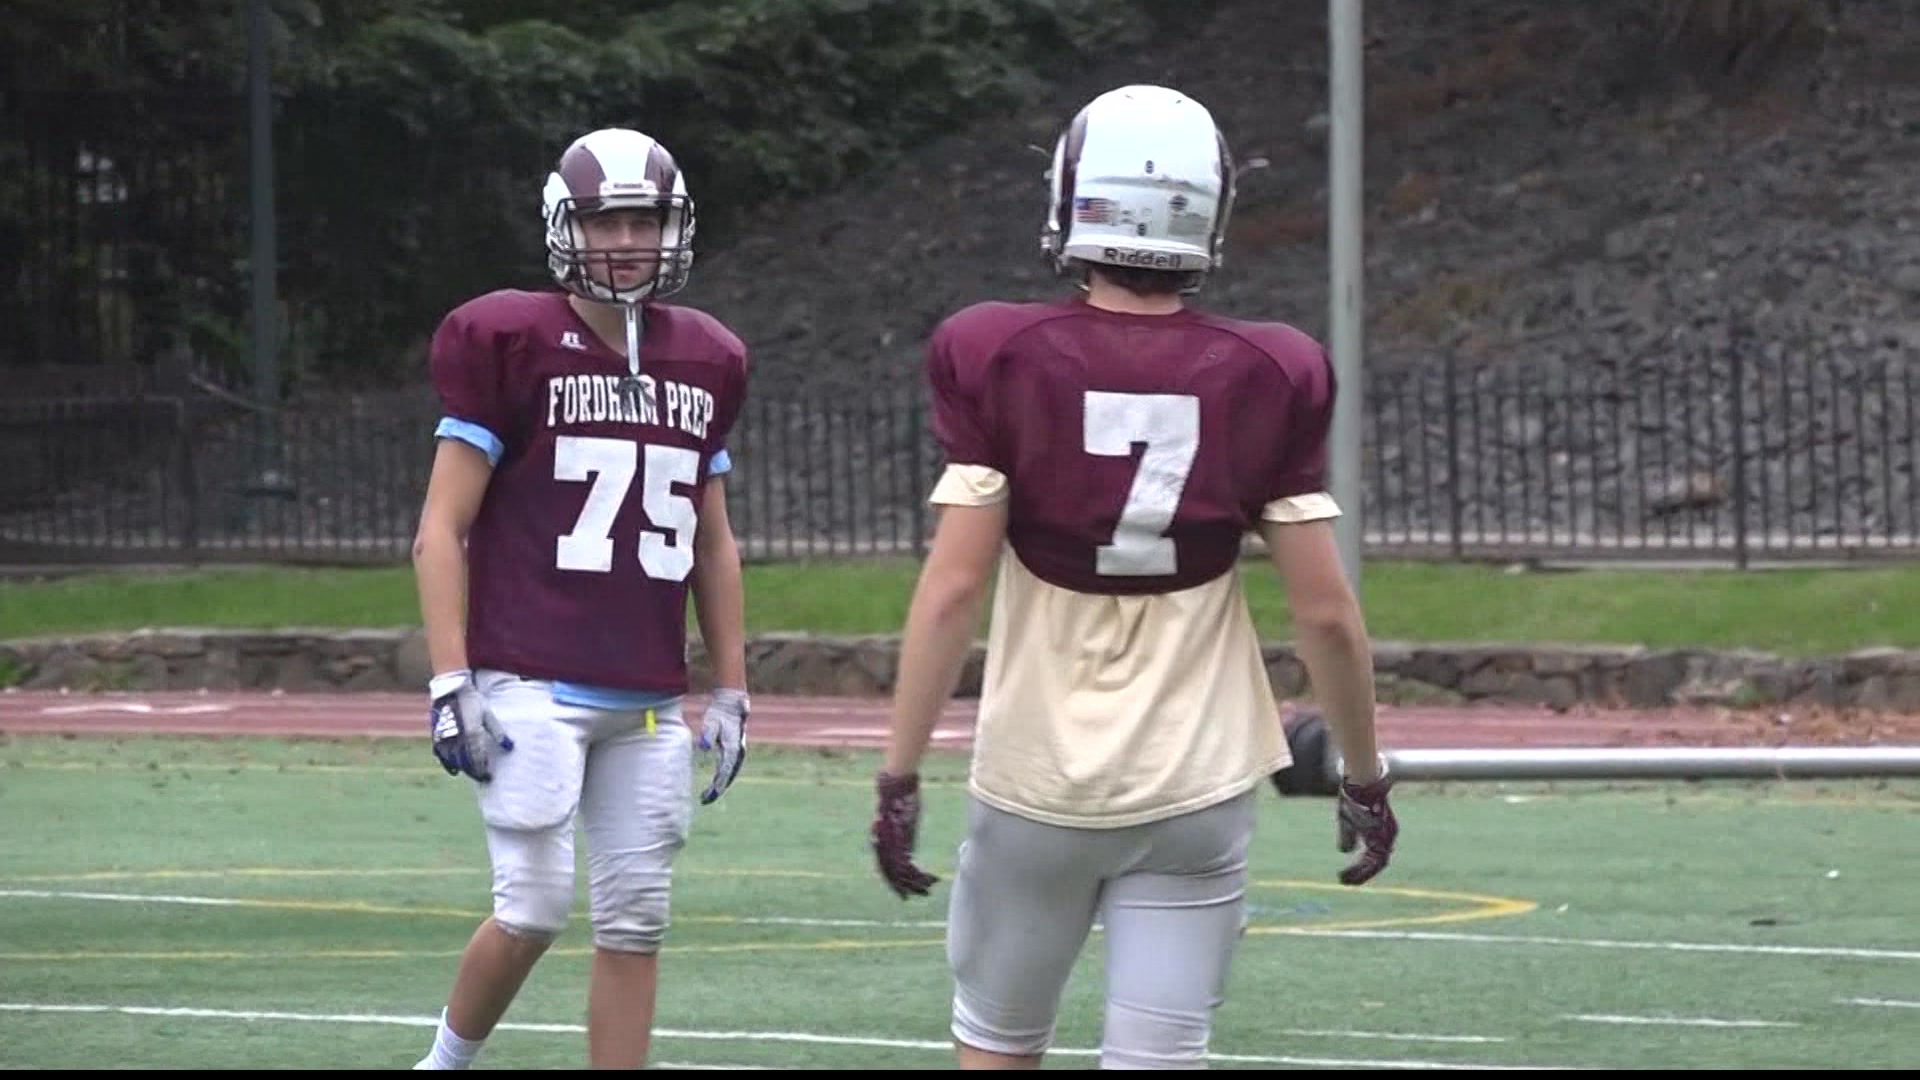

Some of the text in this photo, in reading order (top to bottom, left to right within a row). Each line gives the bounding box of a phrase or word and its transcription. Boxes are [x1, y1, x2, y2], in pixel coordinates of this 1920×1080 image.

[1104, 247, 1182, 269] Riddell
[664, 381, 714, 439] PREP
[554, 436, 701, 582] 75
[1083, 390, 1200, 576] 7
